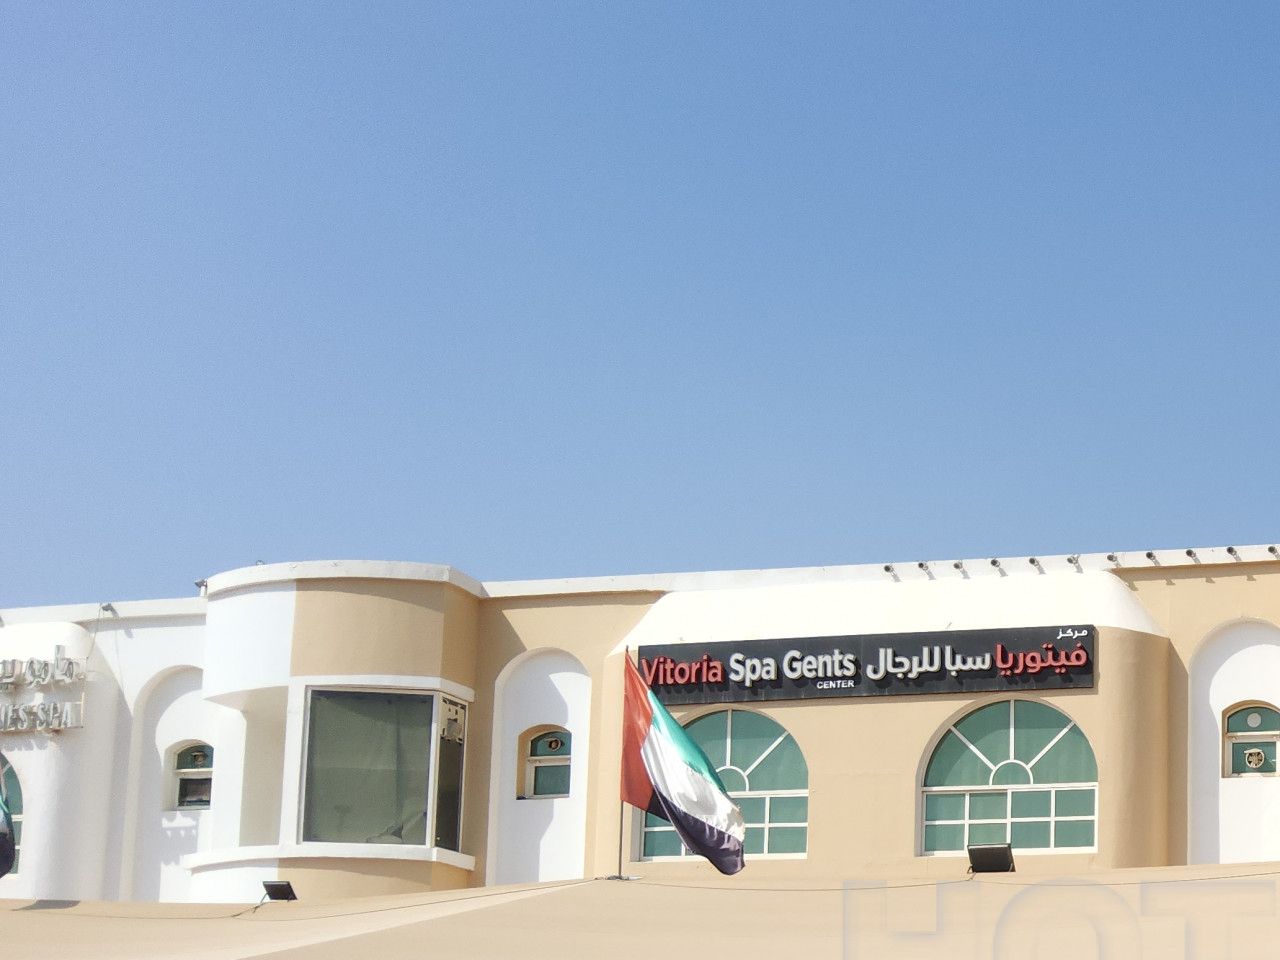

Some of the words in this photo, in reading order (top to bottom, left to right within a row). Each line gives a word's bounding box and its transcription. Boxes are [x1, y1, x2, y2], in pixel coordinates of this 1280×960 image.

[1056, 628, 1088, 640] مركز
[640, 653, 723, 685] Vitoria
[728, 652, 778, 687] Spa
[782, 649, 857, 681] Gents
[866, 645, 942, 681] للرجال
[944, 645, 992, 677] سبا
[995, 640, 1087, 677] فيتوريا
[816, 679, 855, 690] CENTER
